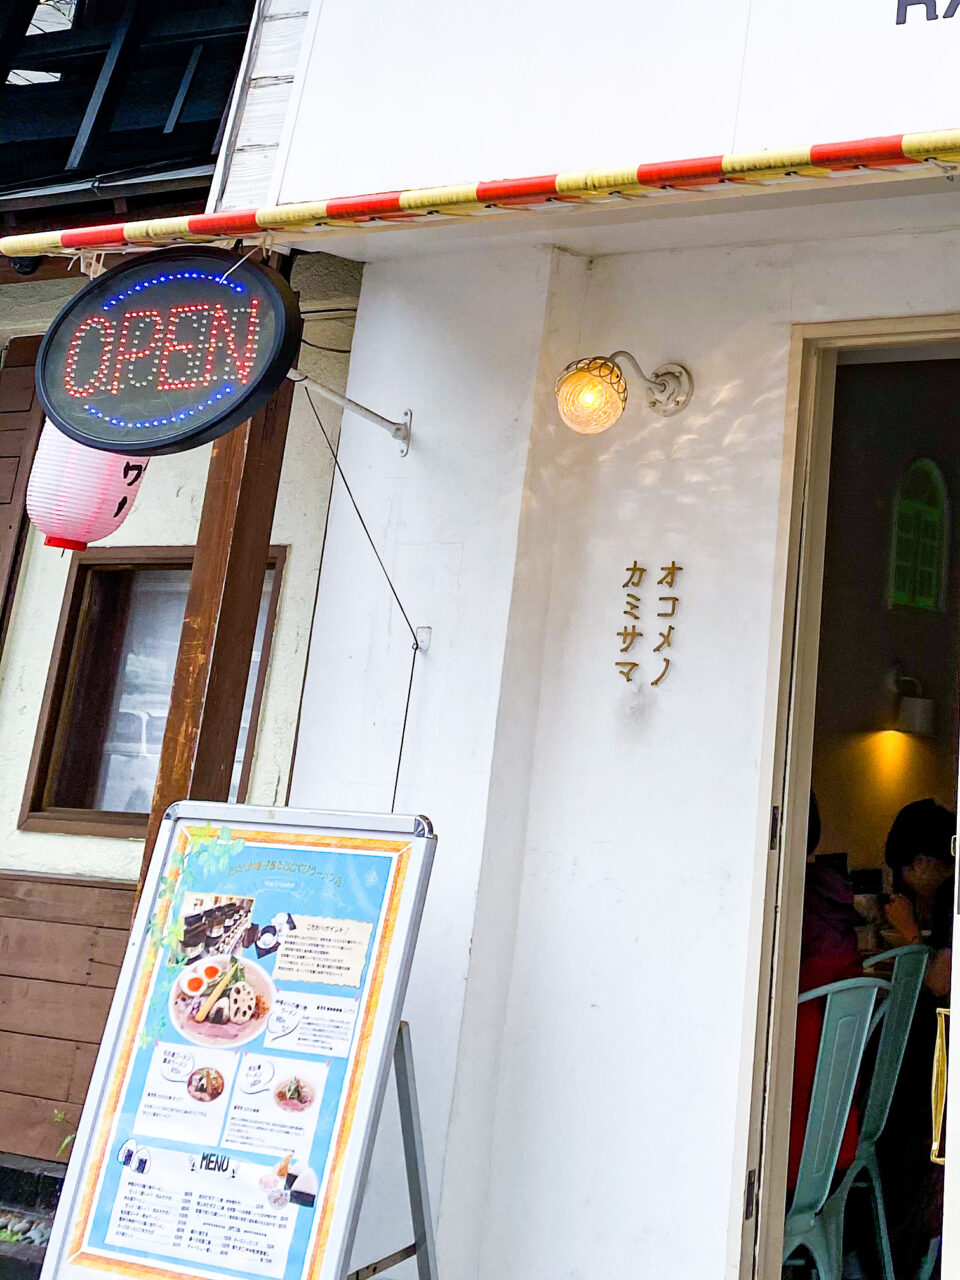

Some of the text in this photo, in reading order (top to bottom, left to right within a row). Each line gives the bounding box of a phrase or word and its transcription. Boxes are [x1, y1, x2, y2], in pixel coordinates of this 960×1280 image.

[63, 297, 260, 400] OPEN
[615, 560, 648, 683] カミサマ
[651, 560, 684, 687] オコメノ
[199, 1151, 231, 1173] MENU
